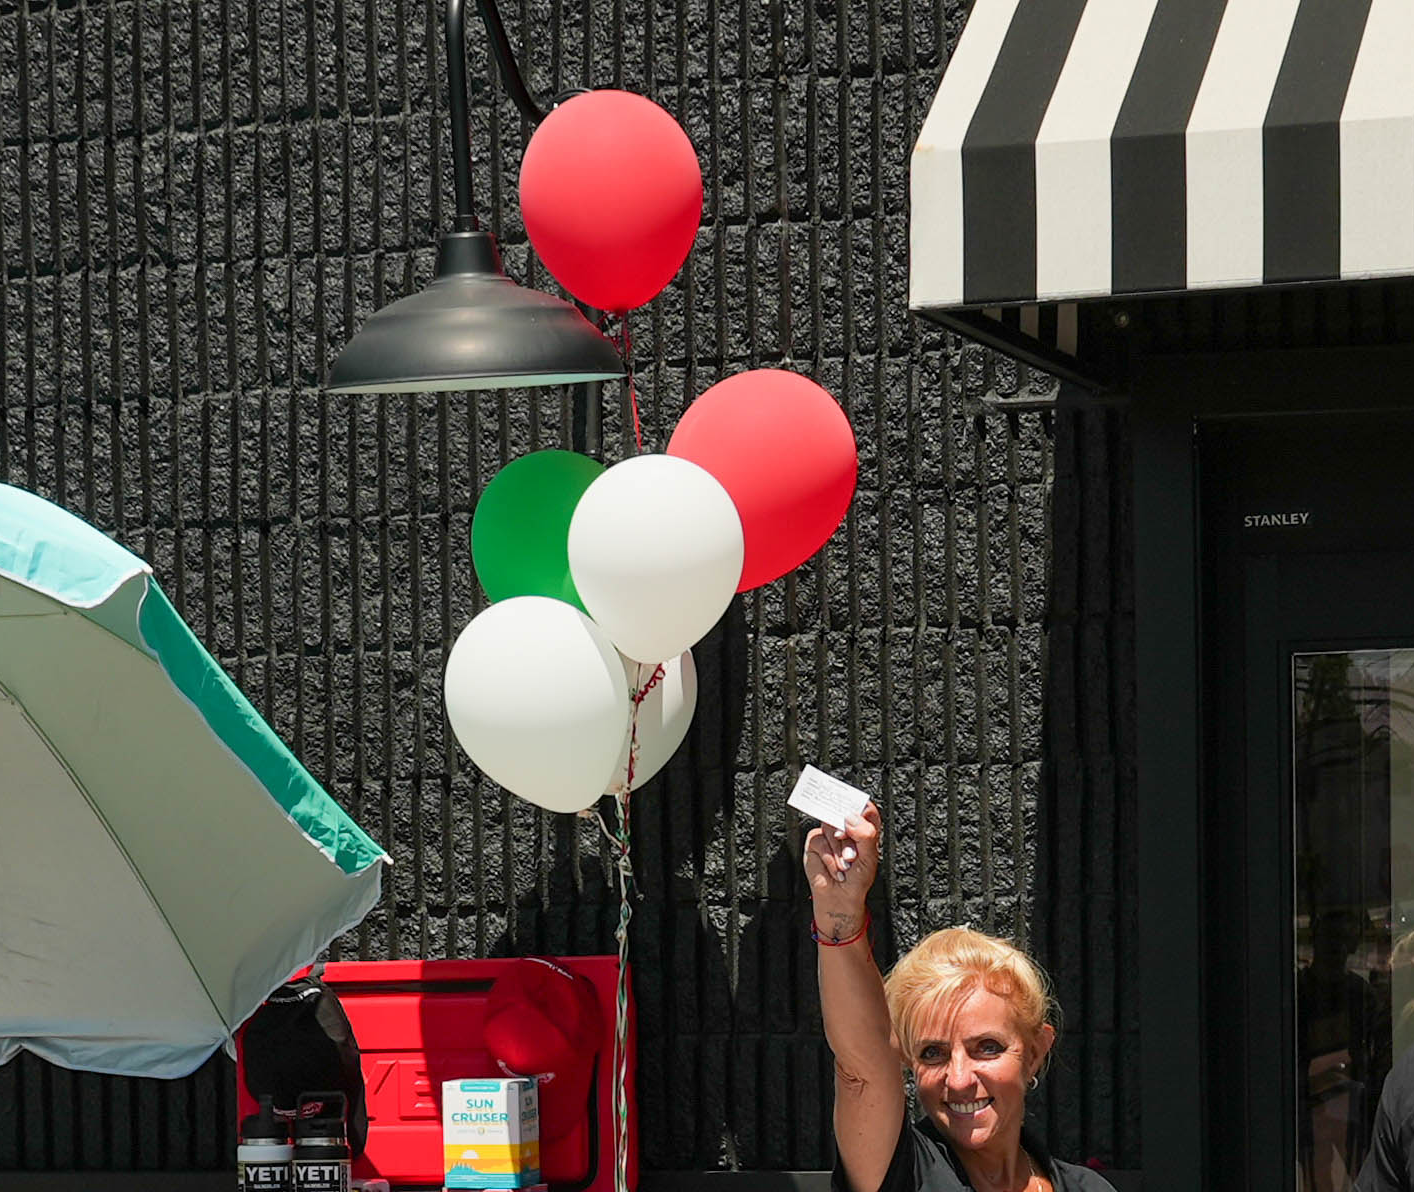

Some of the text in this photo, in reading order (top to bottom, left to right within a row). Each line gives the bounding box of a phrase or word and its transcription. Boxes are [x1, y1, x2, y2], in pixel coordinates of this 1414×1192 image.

[1244, 512, 1309, 527] STANLEY
[466, 1098, 495, 1109] SUN
[451, 1112, 509, 1122] CRUISER
[246, 1166, 289, 1182] YETI
[296, 1165, 339, 1181] YETI
